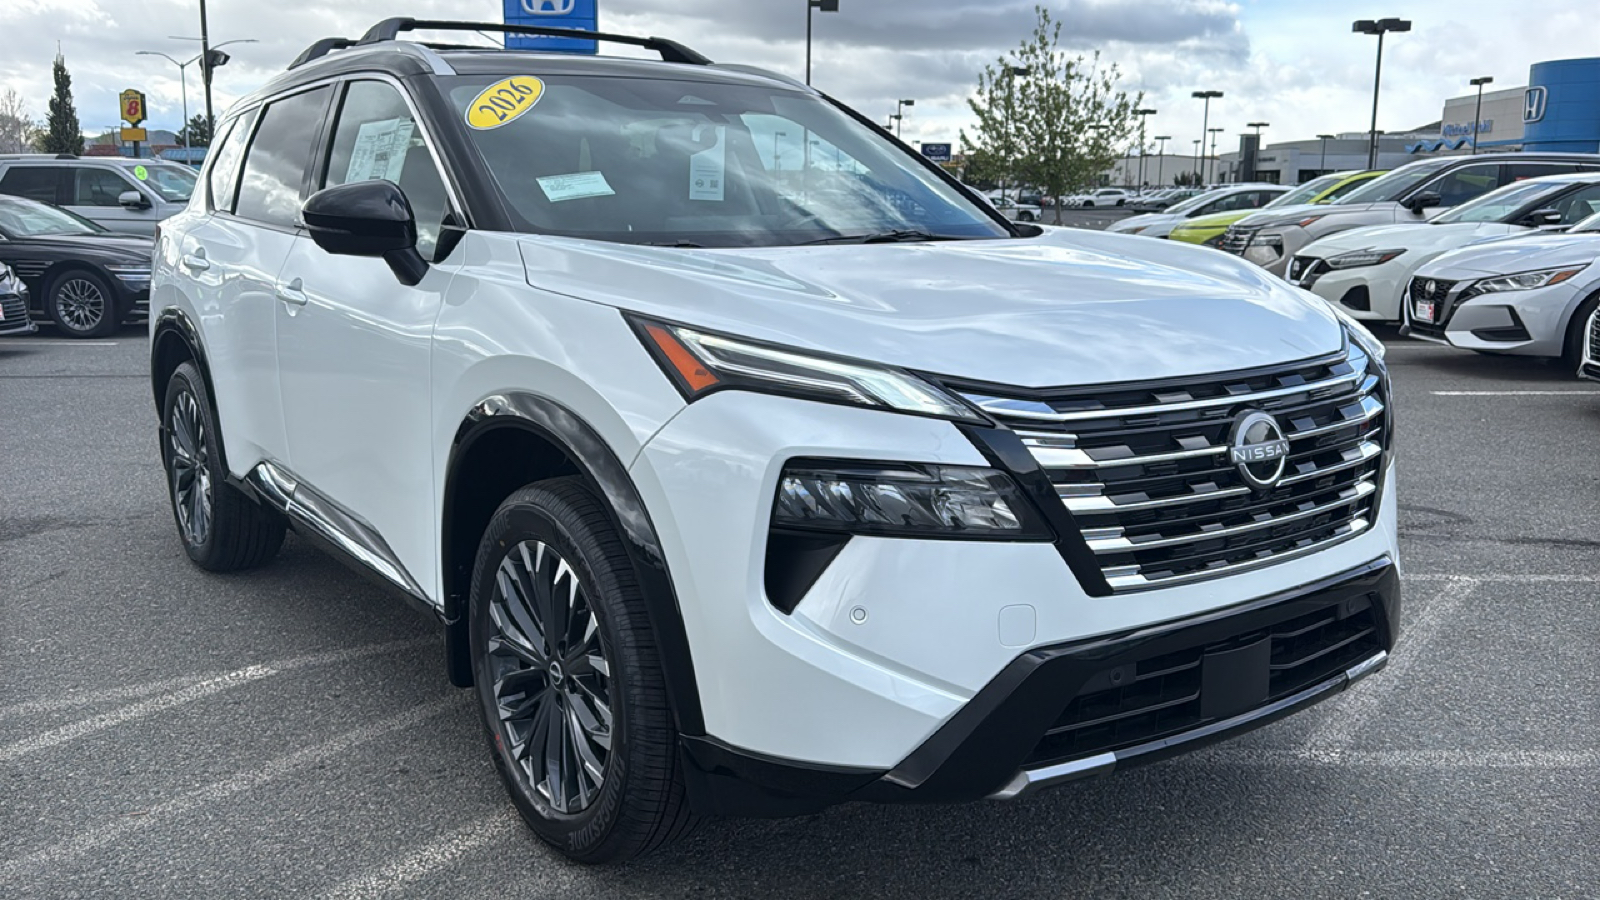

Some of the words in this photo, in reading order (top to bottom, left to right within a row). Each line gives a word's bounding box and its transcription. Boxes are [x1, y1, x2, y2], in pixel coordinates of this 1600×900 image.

[126, 101, 139, 116] 8
[479, 80, 533, 121] 2026
[1233, 443, 1289, 461] NISSAN
